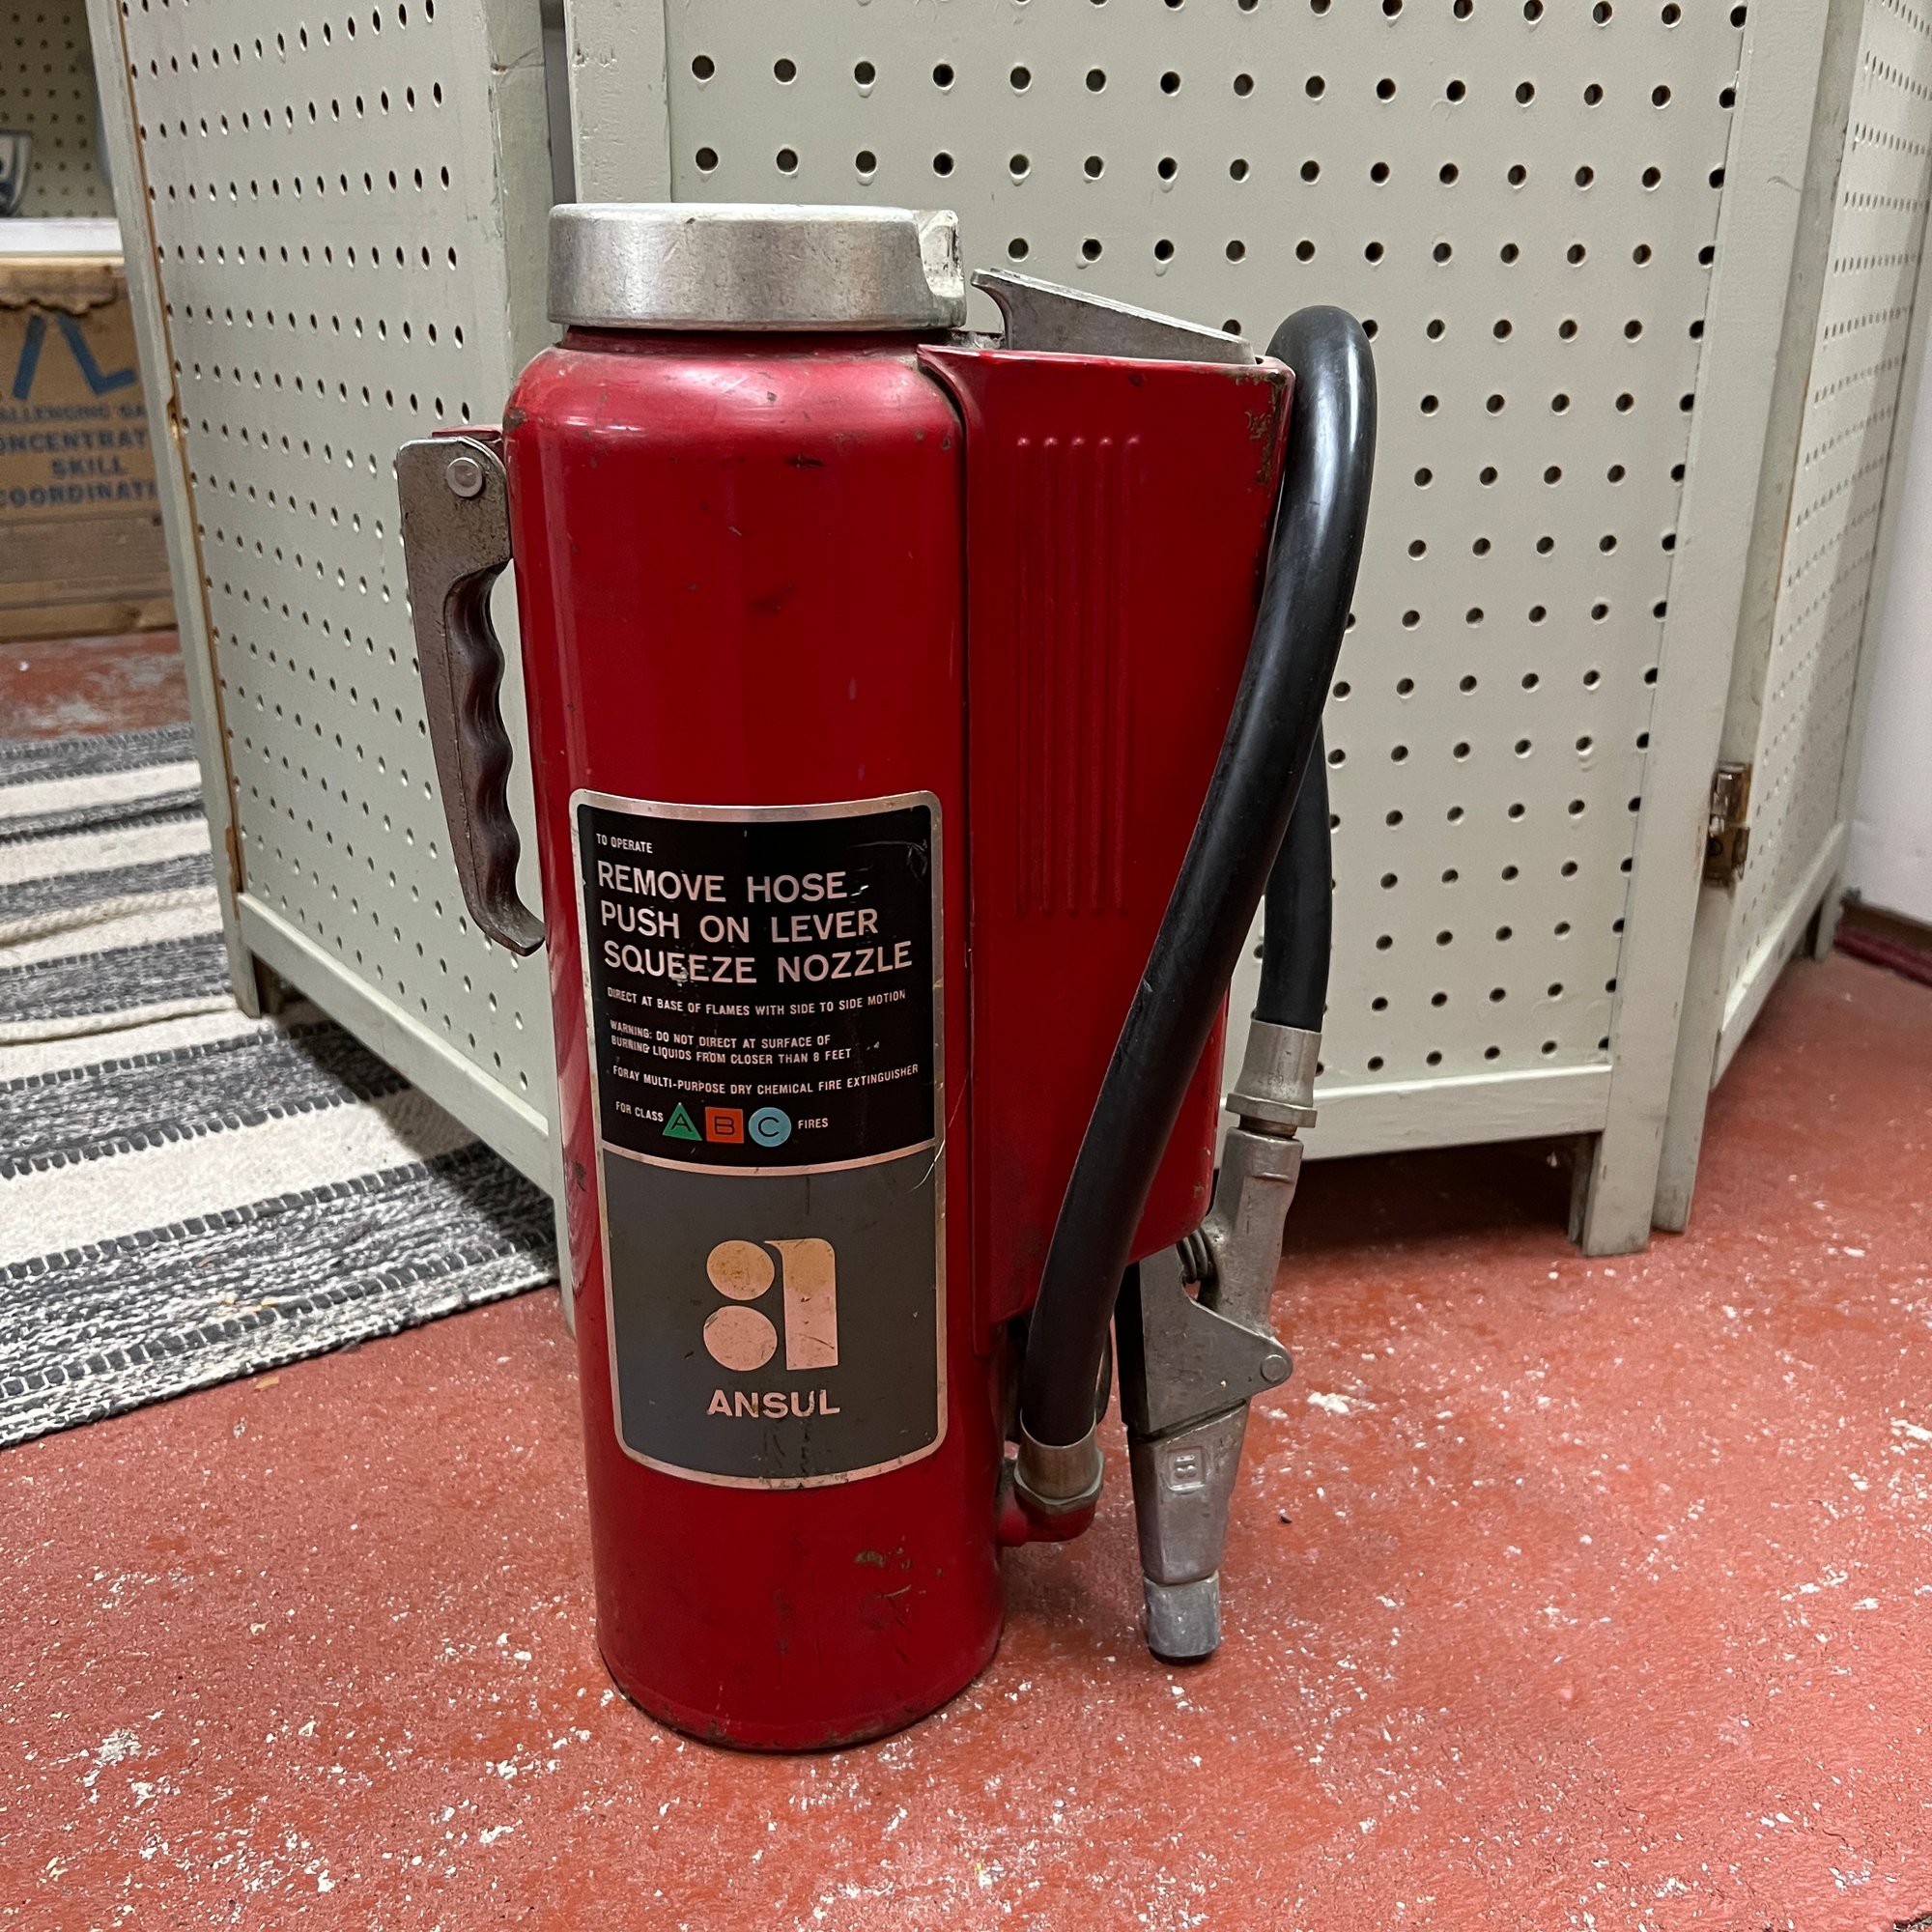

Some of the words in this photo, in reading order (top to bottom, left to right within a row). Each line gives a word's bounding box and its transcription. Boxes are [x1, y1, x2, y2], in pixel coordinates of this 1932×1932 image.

[52, 455, 128, 479] SKILL
[596, 833, 608, 846] TO
[611, 837, 653, 854] OPERATE
[597, 860, 726, 902] REMOVE
[747, 871, 848, 903] HOSE
[601, 899, 680, 939] PUSH
[699, 915, 750, 943] ON
[771, 908, 878, 943] LEVER
[604, 940, 757, 983] SQUEEZE
[777, 940, 913, 983] NOZZLE
[607, 986, 638, 1004] DIRECT
[641, 996, 653, 1007] AT
[657, 998, 684, 1011] BASE
[687, 1002, 701, 1013] OF
[705, 1004, 750, 1016] FLAMES
[755, 1005, 784, 1015] WITH
[789, 1003, 815, 1014] SIDE
[819, 1002, 834, 1012] TO
[838, 997, 863, 1010] SIDE
[867, 989, 906, 1006] MOTION
[610, 1019, 652, 1039] WARNING:
[656, 1031, 669, 1042] DO
[673, 1034, 695, 1045] NOT
[698, 1036, 737, 1049] DIRECT
[742, 1037, 756, 1049] AT
[761, 1036, 812, 1049] SURFACE
[816, 1034, 831, 1046] OF
[611, 1035, 650, 1054] BURNING
[652, 1045, 692, 1061] LIQUIDS
[696, 1051, 726, 1064] FROM
[730, 1053, 773, 1065] CLOSER
[778, 1052, 809, 1064] THAN
[812, 1052, 820, 1063] 8
[825, 1048, 852, 1062] FEET
[612, 1065, 640, 1082] FORAY
[643, 1073, 726, 1094] MULTI-PURPOSE
[730, 1084, 753, 1094] DRY
[757, 1083, 813, 1095] CHEMICAL
[818, 1079, 842, 1093] FIRE
[846, 1064, 919, 1089] EXTINGUISHER
[615, 1101, 632, 1115] FOR
[635, 1106, 665, 1122] CLASS
[670, 1112, 693, 1133] A
[714, 1116, 735, 1136] B
[757, 1116, 781, 1138] C
[797, 1117, 829, 1129] FIRES
[706, 1388, 840, 1419] ANSUL
